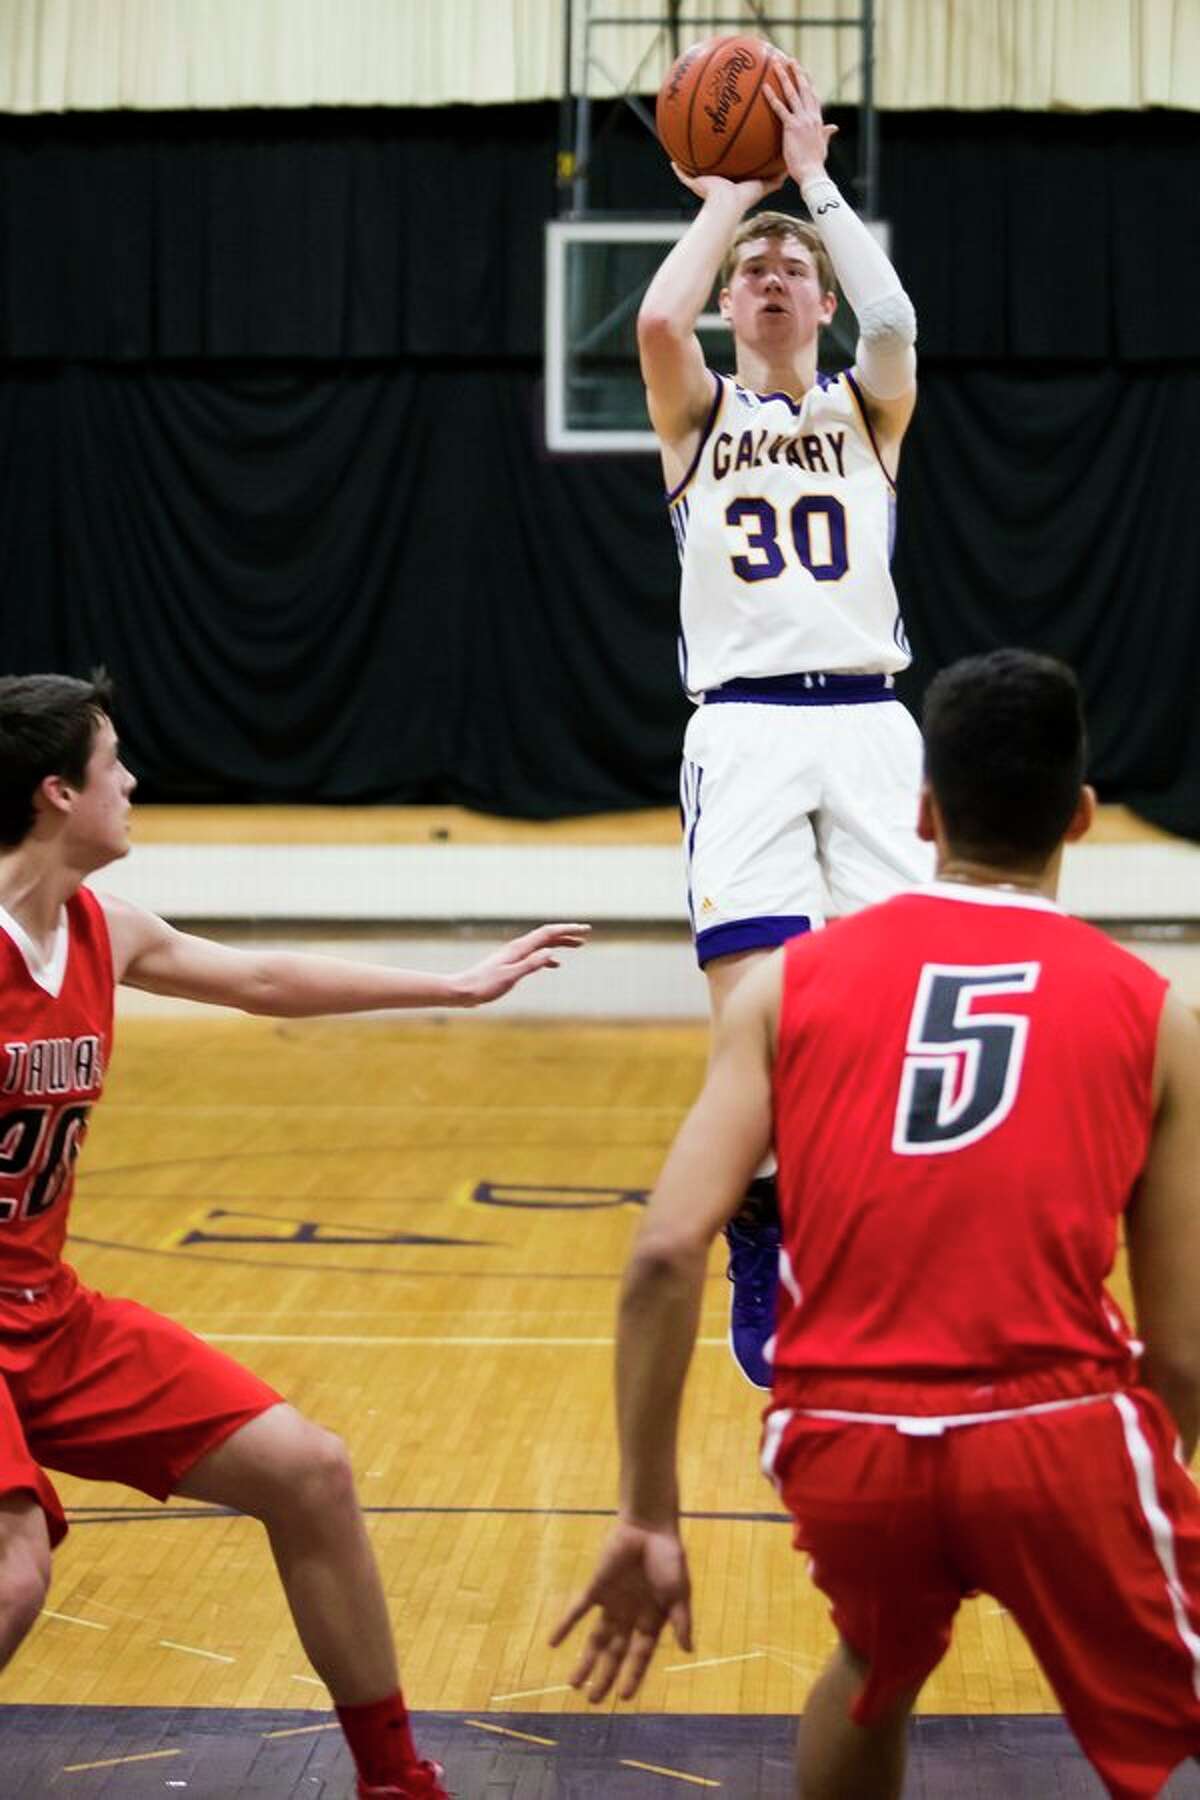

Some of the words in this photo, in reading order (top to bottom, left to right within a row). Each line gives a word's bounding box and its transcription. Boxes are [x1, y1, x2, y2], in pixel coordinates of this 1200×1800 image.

[704, 47, 757, 134] Rawlings
[712, 429, 846, 481] CALVARY
[725, 494, 850, 584] 30
[2, 1035, 103, 1095] TAWA
[891, 961, 1042, 1155] 5
